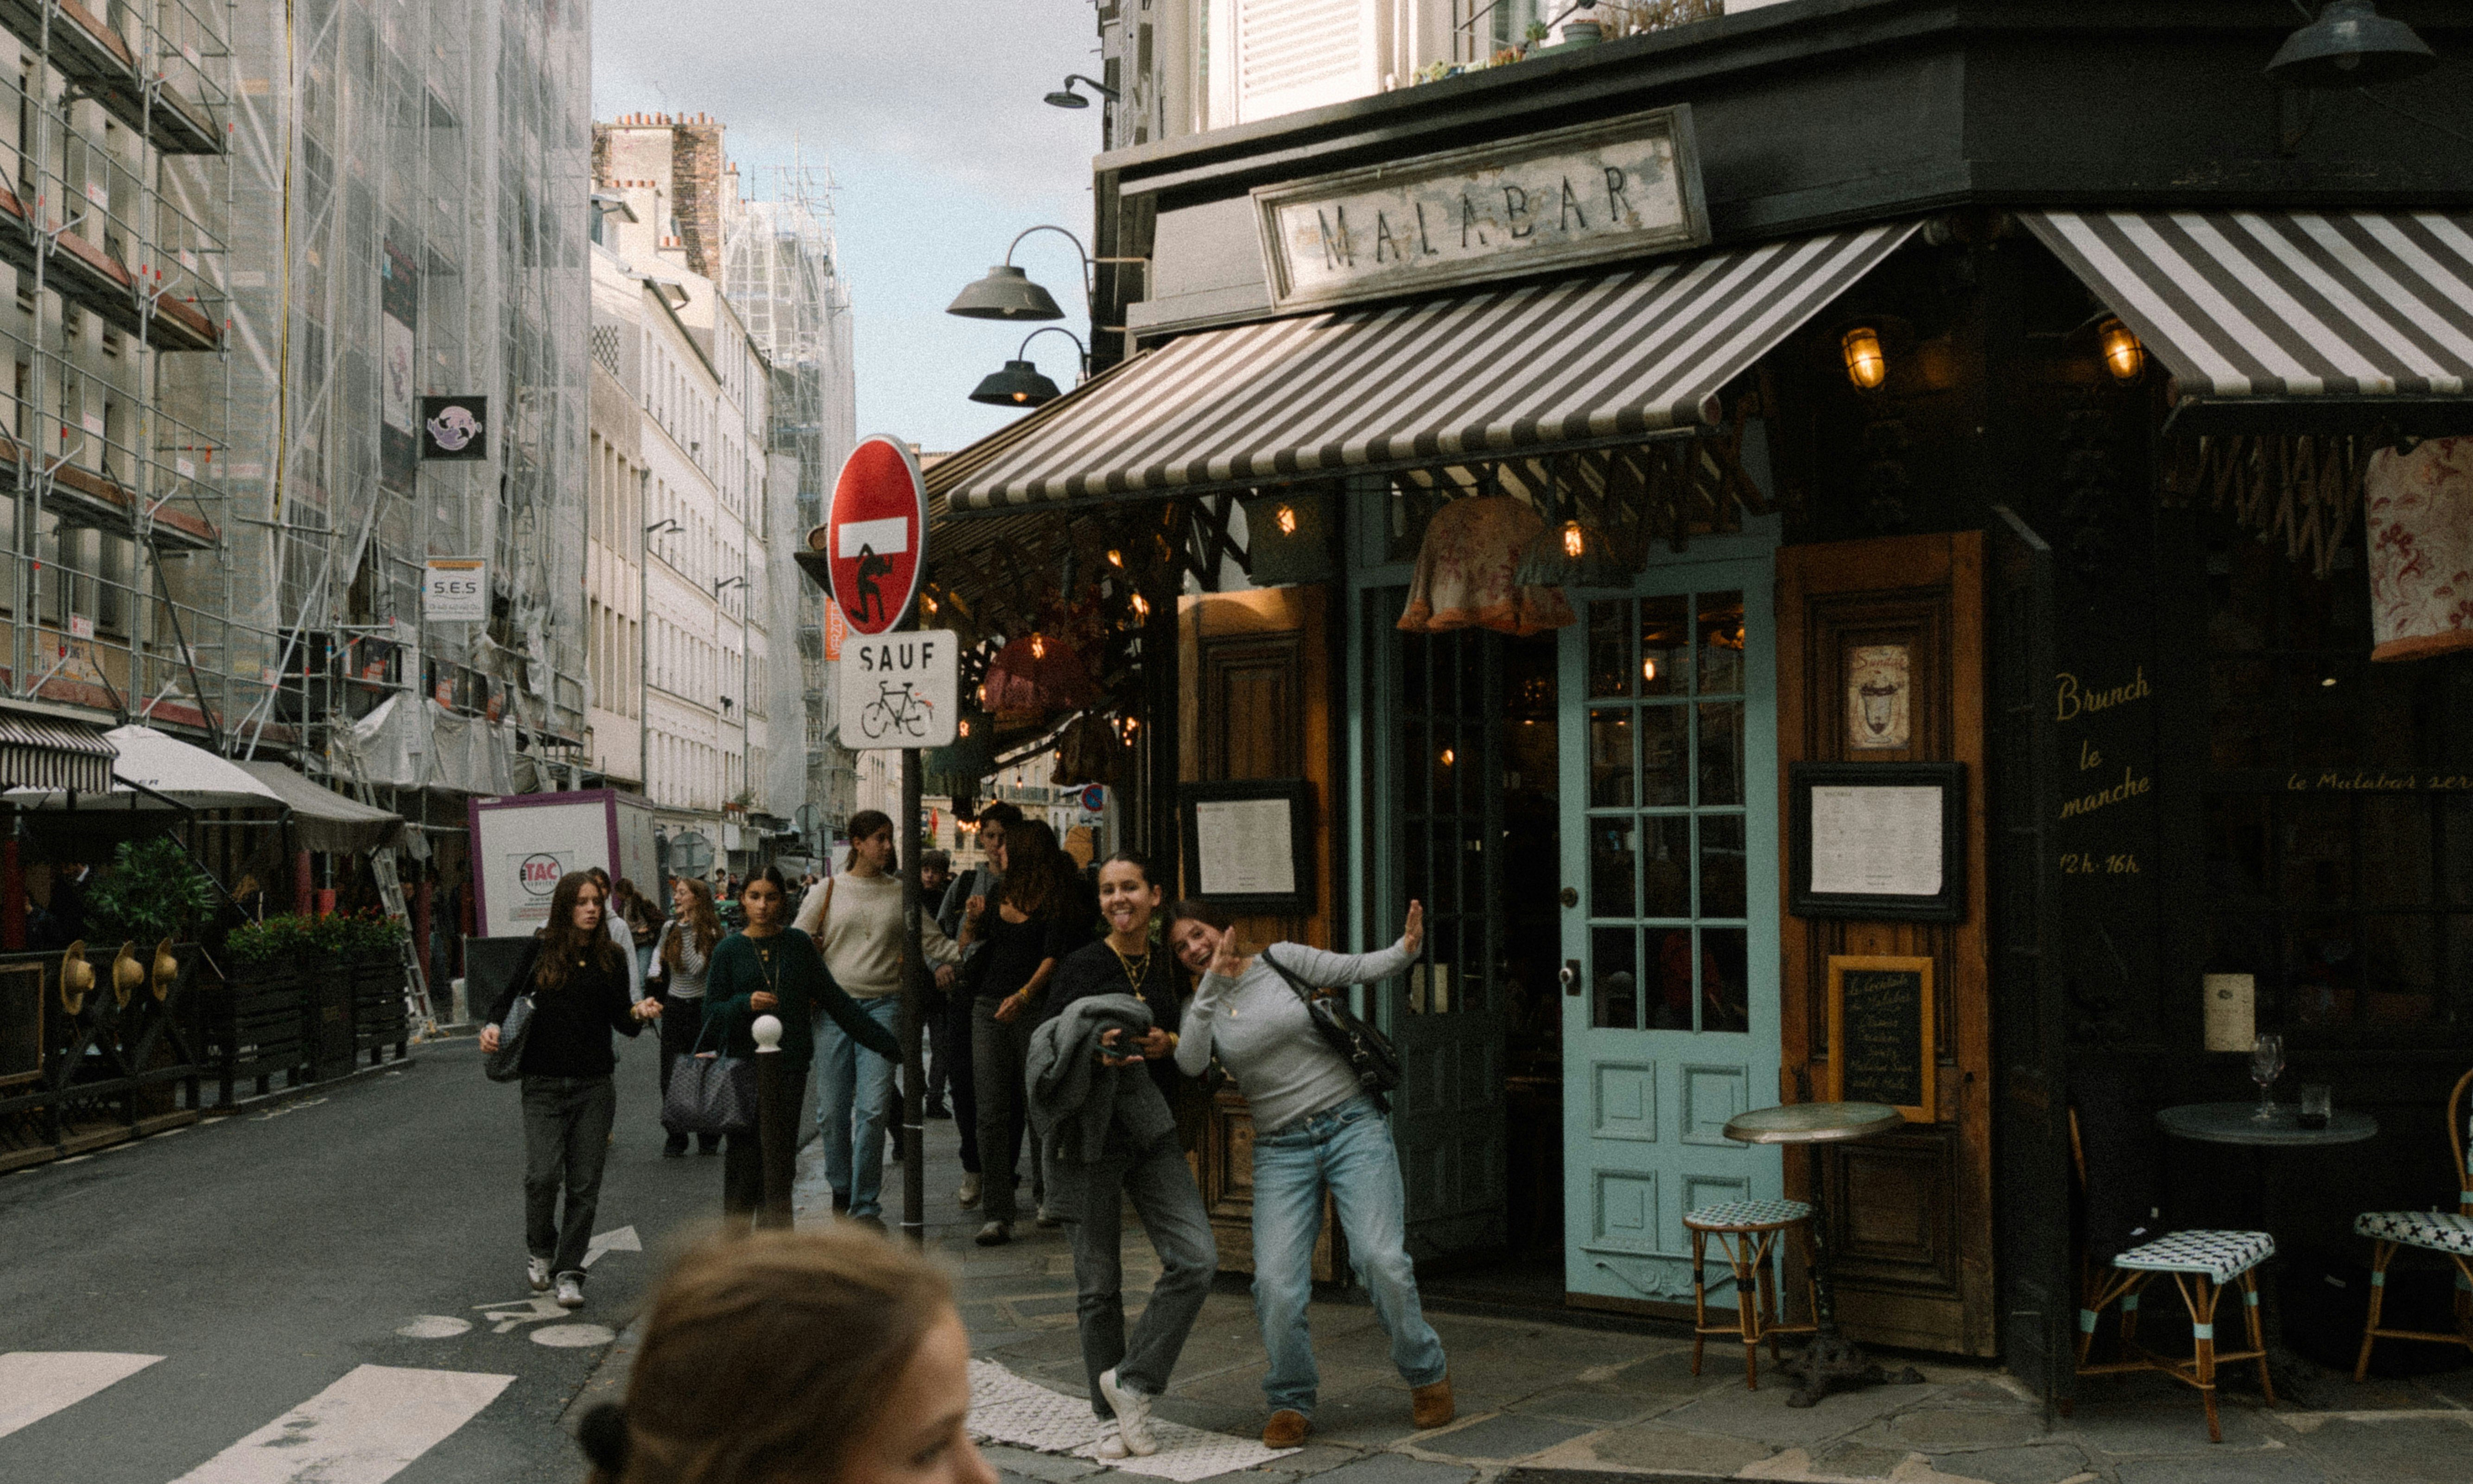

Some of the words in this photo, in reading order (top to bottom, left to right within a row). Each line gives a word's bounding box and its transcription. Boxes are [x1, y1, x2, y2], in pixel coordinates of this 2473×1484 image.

[1319, 166, 1630, 271] MALABAR
[860, 642, 934, 672] SAUF
[2056, 665, 2151, 721] Brunch
[2059, 766, 2150, 819] manche
[2316, 772, 2416, 789] Malabar
